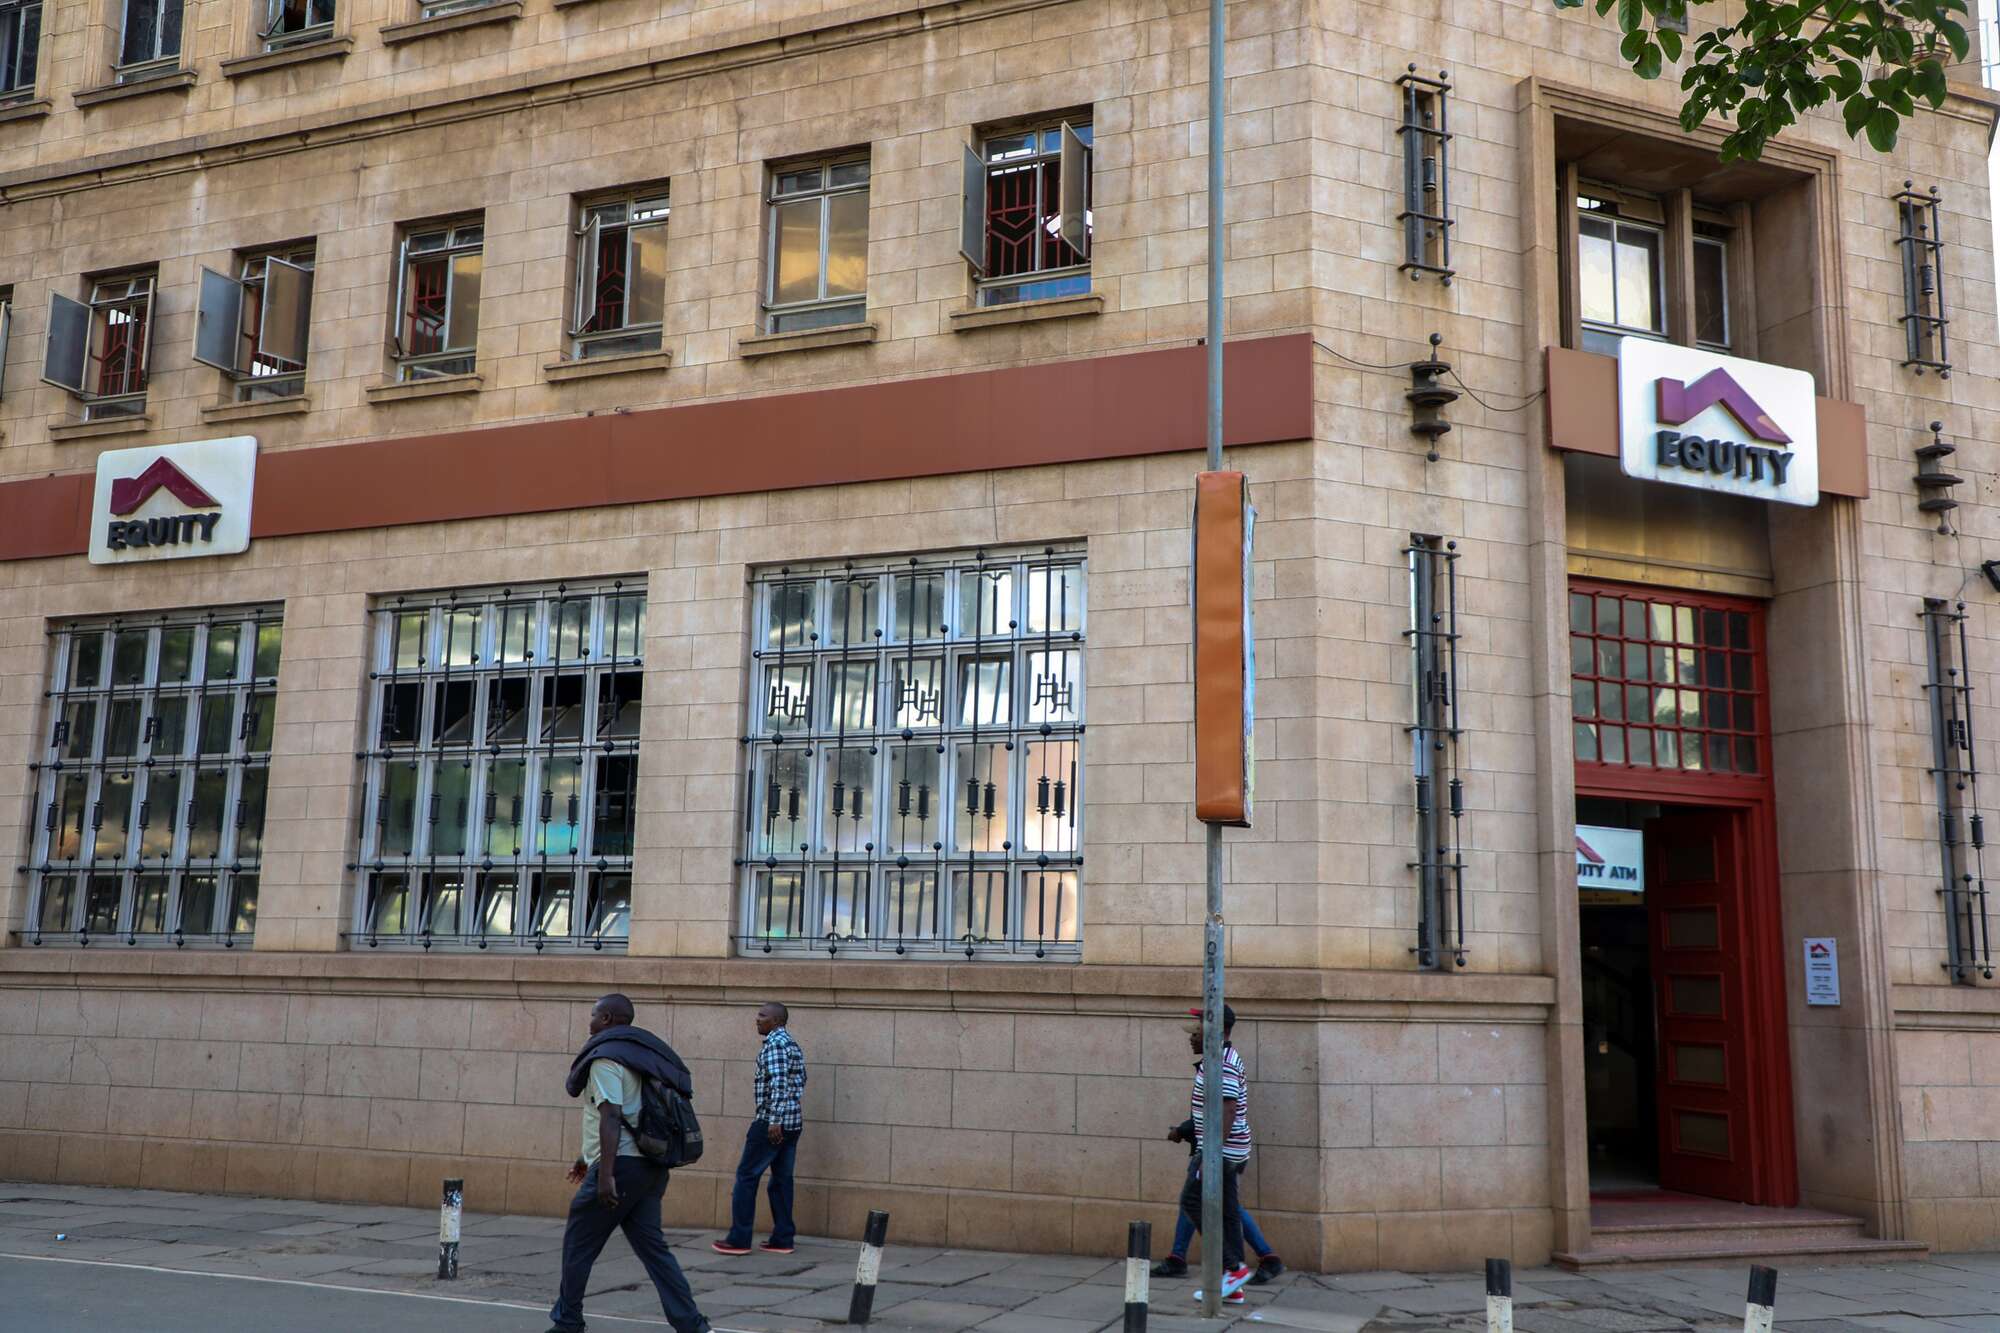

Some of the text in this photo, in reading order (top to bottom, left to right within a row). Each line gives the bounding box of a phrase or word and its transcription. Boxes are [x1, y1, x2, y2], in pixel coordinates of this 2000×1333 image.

[1657, 430, 1794, 486] EQUITY
[107, 512, 222, 550] EQUITY
[1609, 866, 1637, 881] ATM
